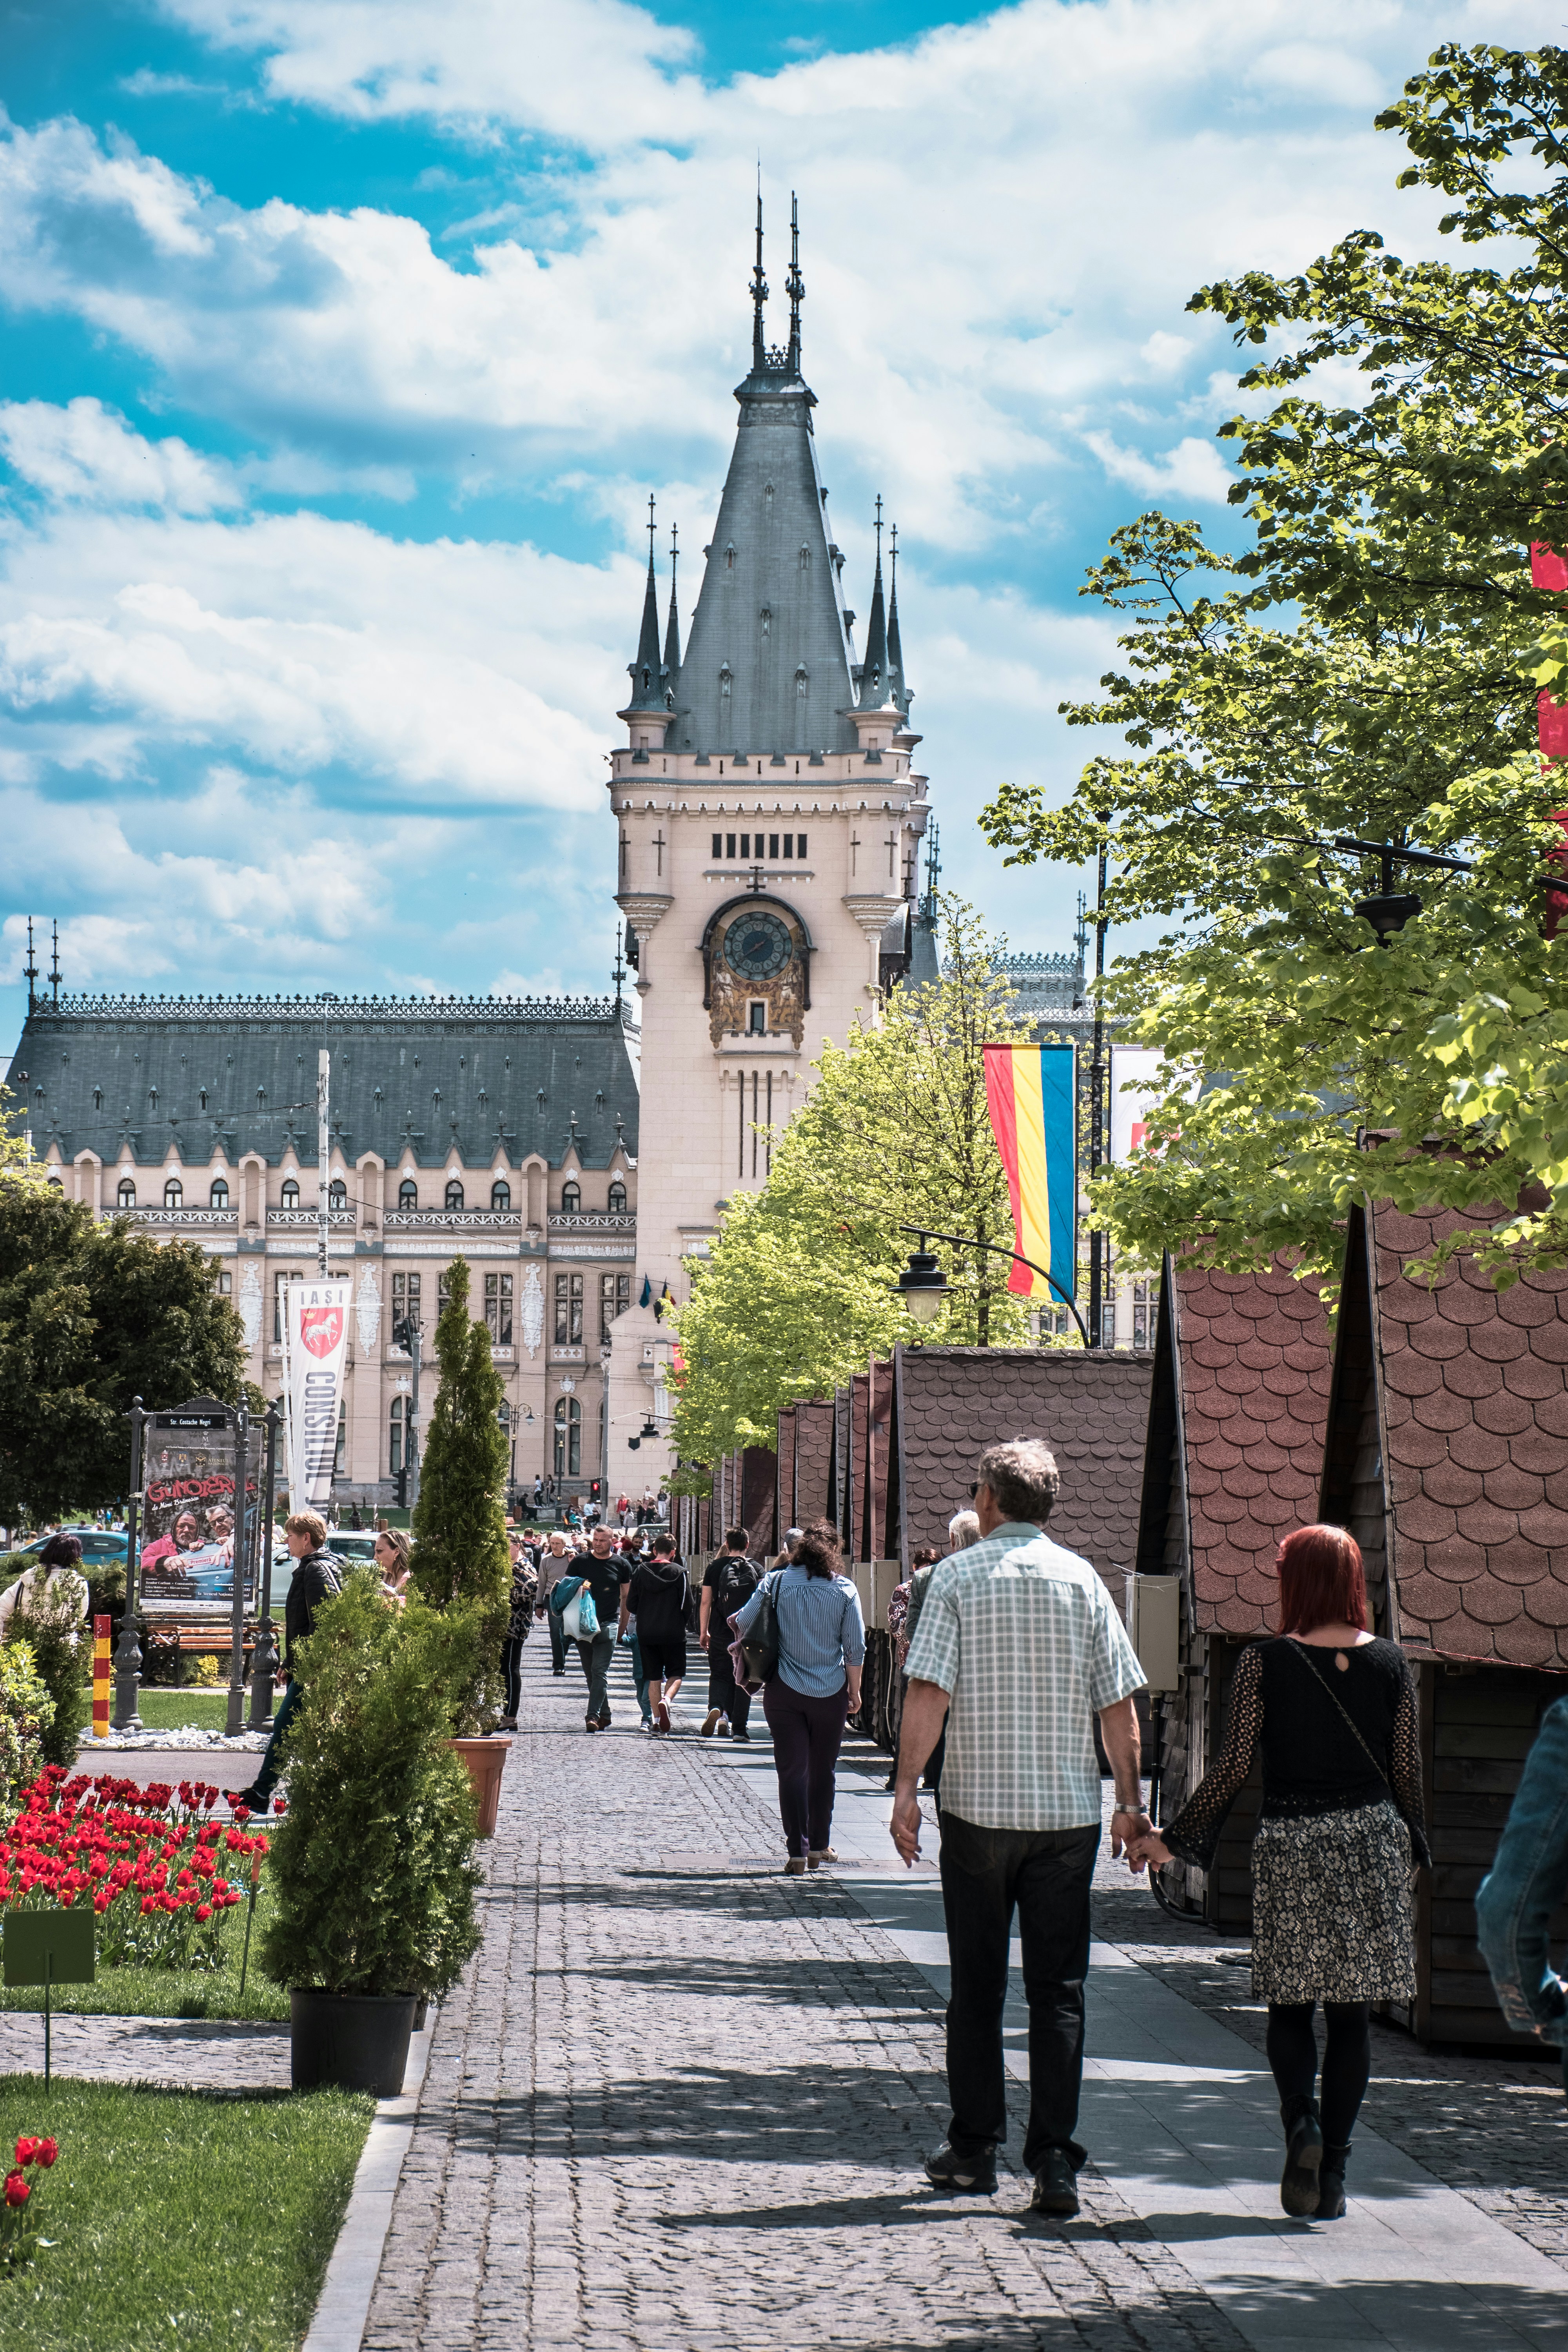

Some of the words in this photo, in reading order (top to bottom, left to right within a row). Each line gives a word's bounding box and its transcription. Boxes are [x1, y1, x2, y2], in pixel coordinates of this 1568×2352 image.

[301, 1290, 343, 1307] IAȘI
[305, 1372, 336, 1483] CONSILIUL
[148, 1475, 256, 1503] GUNOIERL
[159, 1501, 173, 1510] Mimi
[173, 1496, 199, 1505] Brănescu
